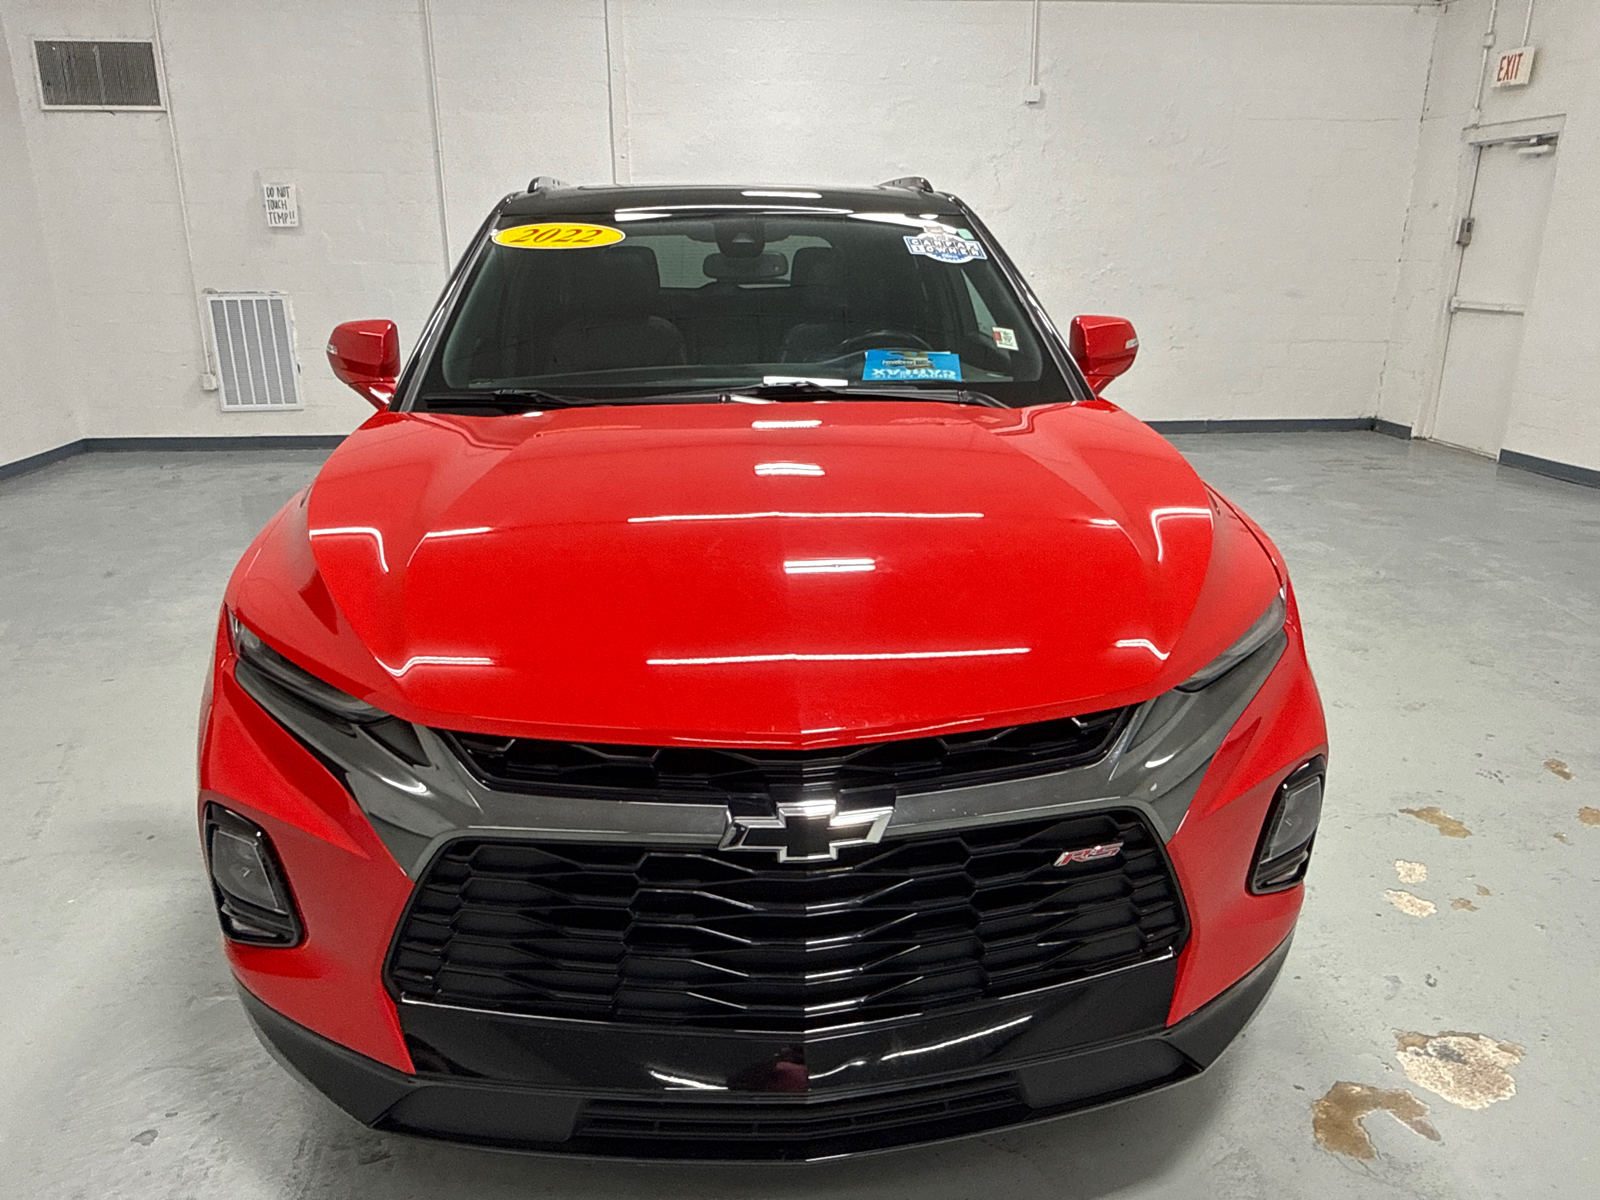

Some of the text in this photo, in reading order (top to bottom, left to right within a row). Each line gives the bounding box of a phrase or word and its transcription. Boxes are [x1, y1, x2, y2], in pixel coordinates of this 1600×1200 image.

[1497, 52, 1524, 82] EXIT
[266, 186, 290, 199] DO NOT
[266, 199, 288, 211] TOUCH
[509, 228, 603, 243] 2022
[1053, 842, 1124, 867] RS
